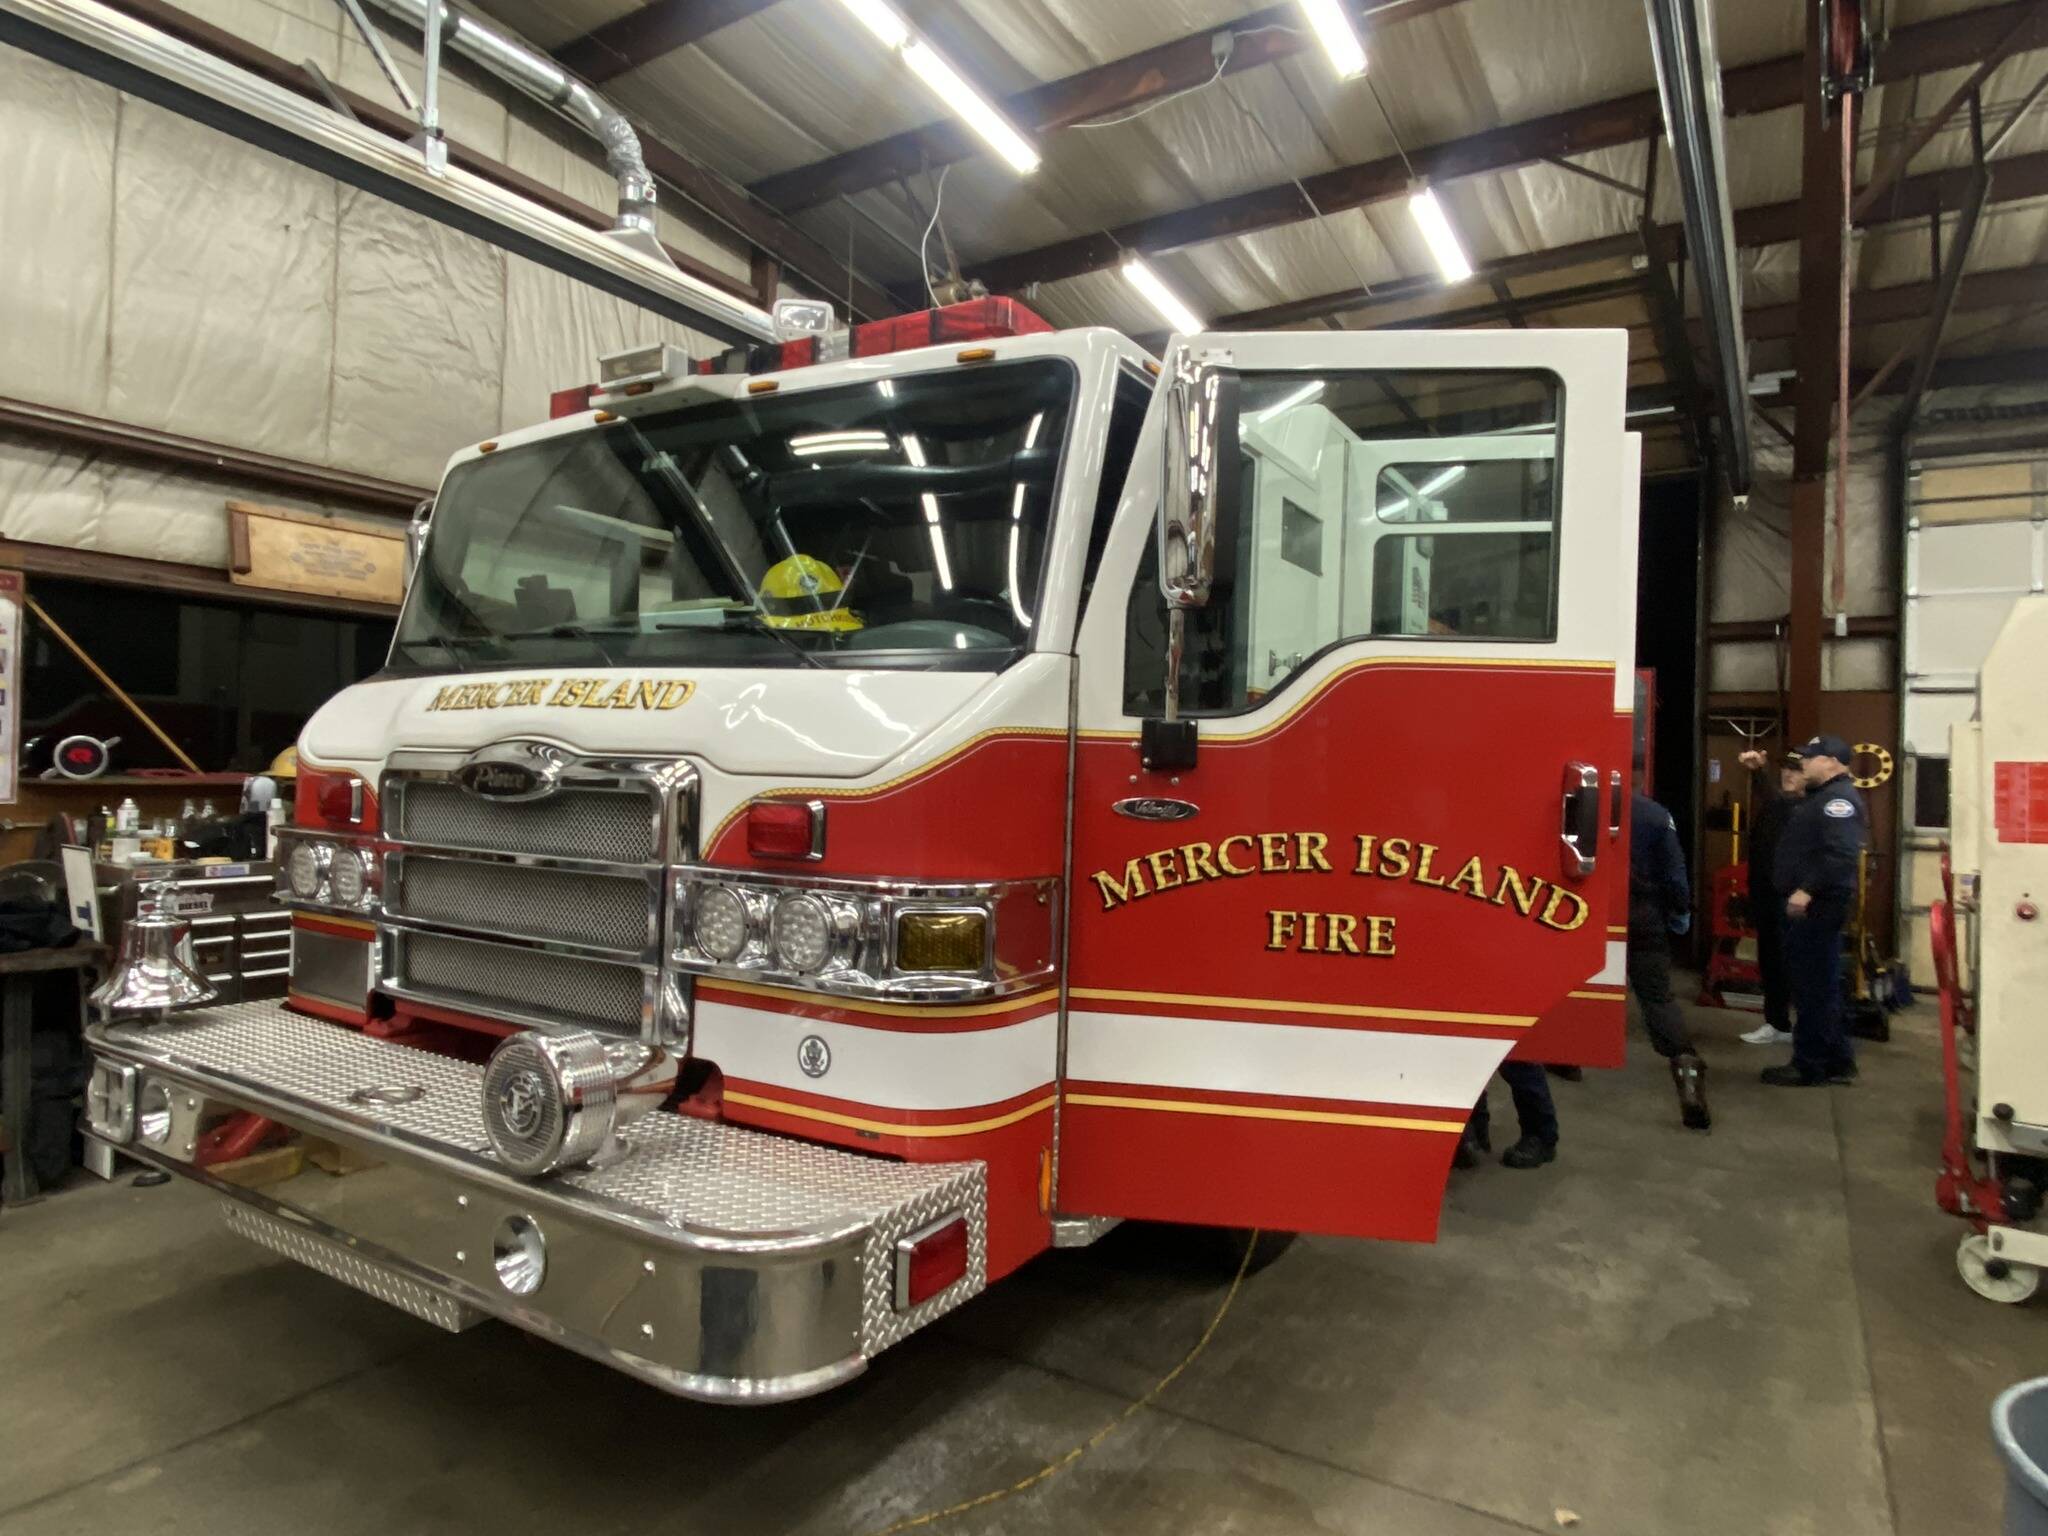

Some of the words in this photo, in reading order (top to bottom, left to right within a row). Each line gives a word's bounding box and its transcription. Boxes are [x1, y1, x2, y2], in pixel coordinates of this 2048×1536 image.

[425, 678, 552, 711] MERCER
[546, 677, 697, 711] ISLAND
[1089, 831, 1334, 913] MERCER
[1353, 833, 1590, 932] ISLAND
[1265, 909, 1397, 956] FIRE
